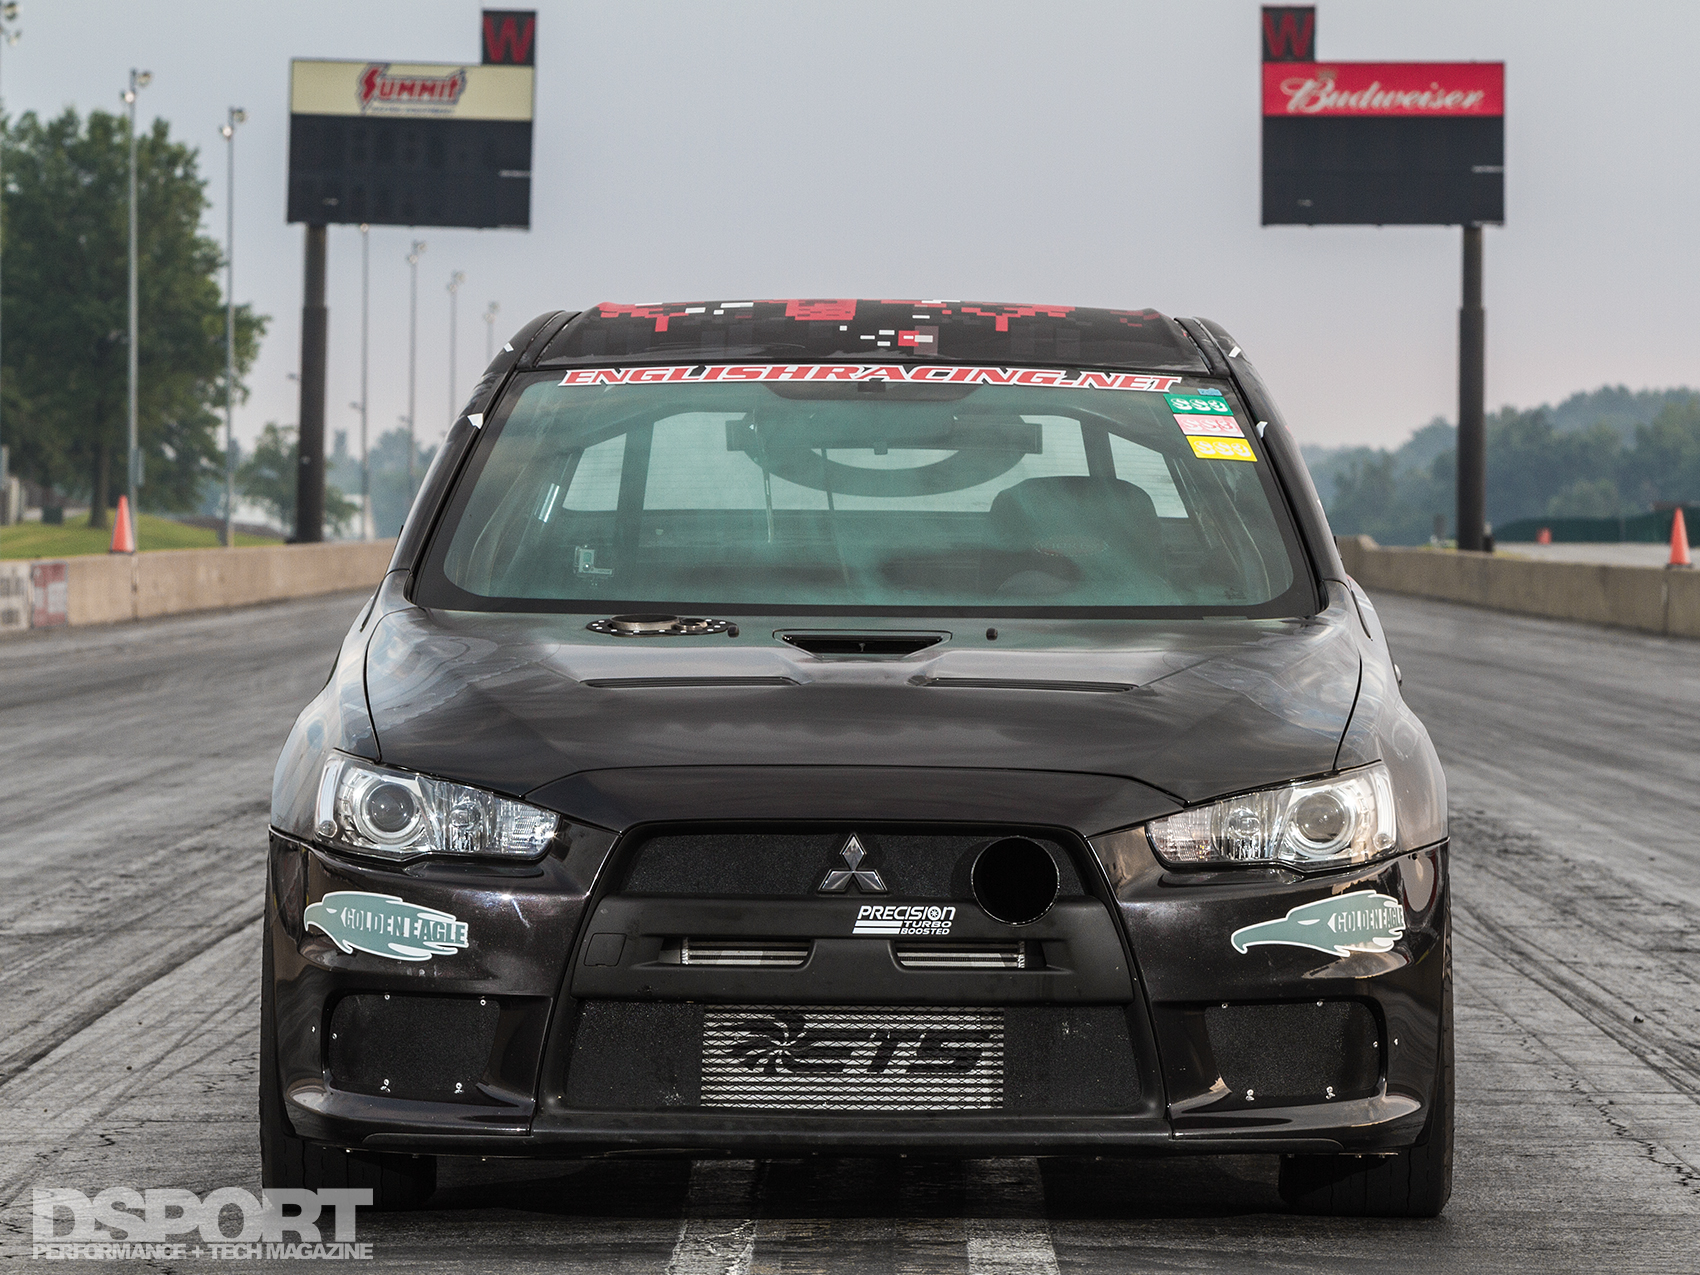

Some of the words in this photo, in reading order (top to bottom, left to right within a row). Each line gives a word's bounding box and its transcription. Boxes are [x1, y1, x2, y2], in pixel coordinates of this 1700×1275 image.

[483, 15, 535, 63] W
[1263, 12, 1314, 58] W
[1280, 77, 1484, 113] Budweiser
[558, 365, 1182, 392] ENGLISHRACING.NET
[343, 907, 404, 937] GOLDEN
[409, 918, 467, 944] EAGLE
[904, 920, 952, 928] TURBO
[1334, 908, 1379, 933] GOLDEN
[1381, 906, 1404, 929] EAGLE
